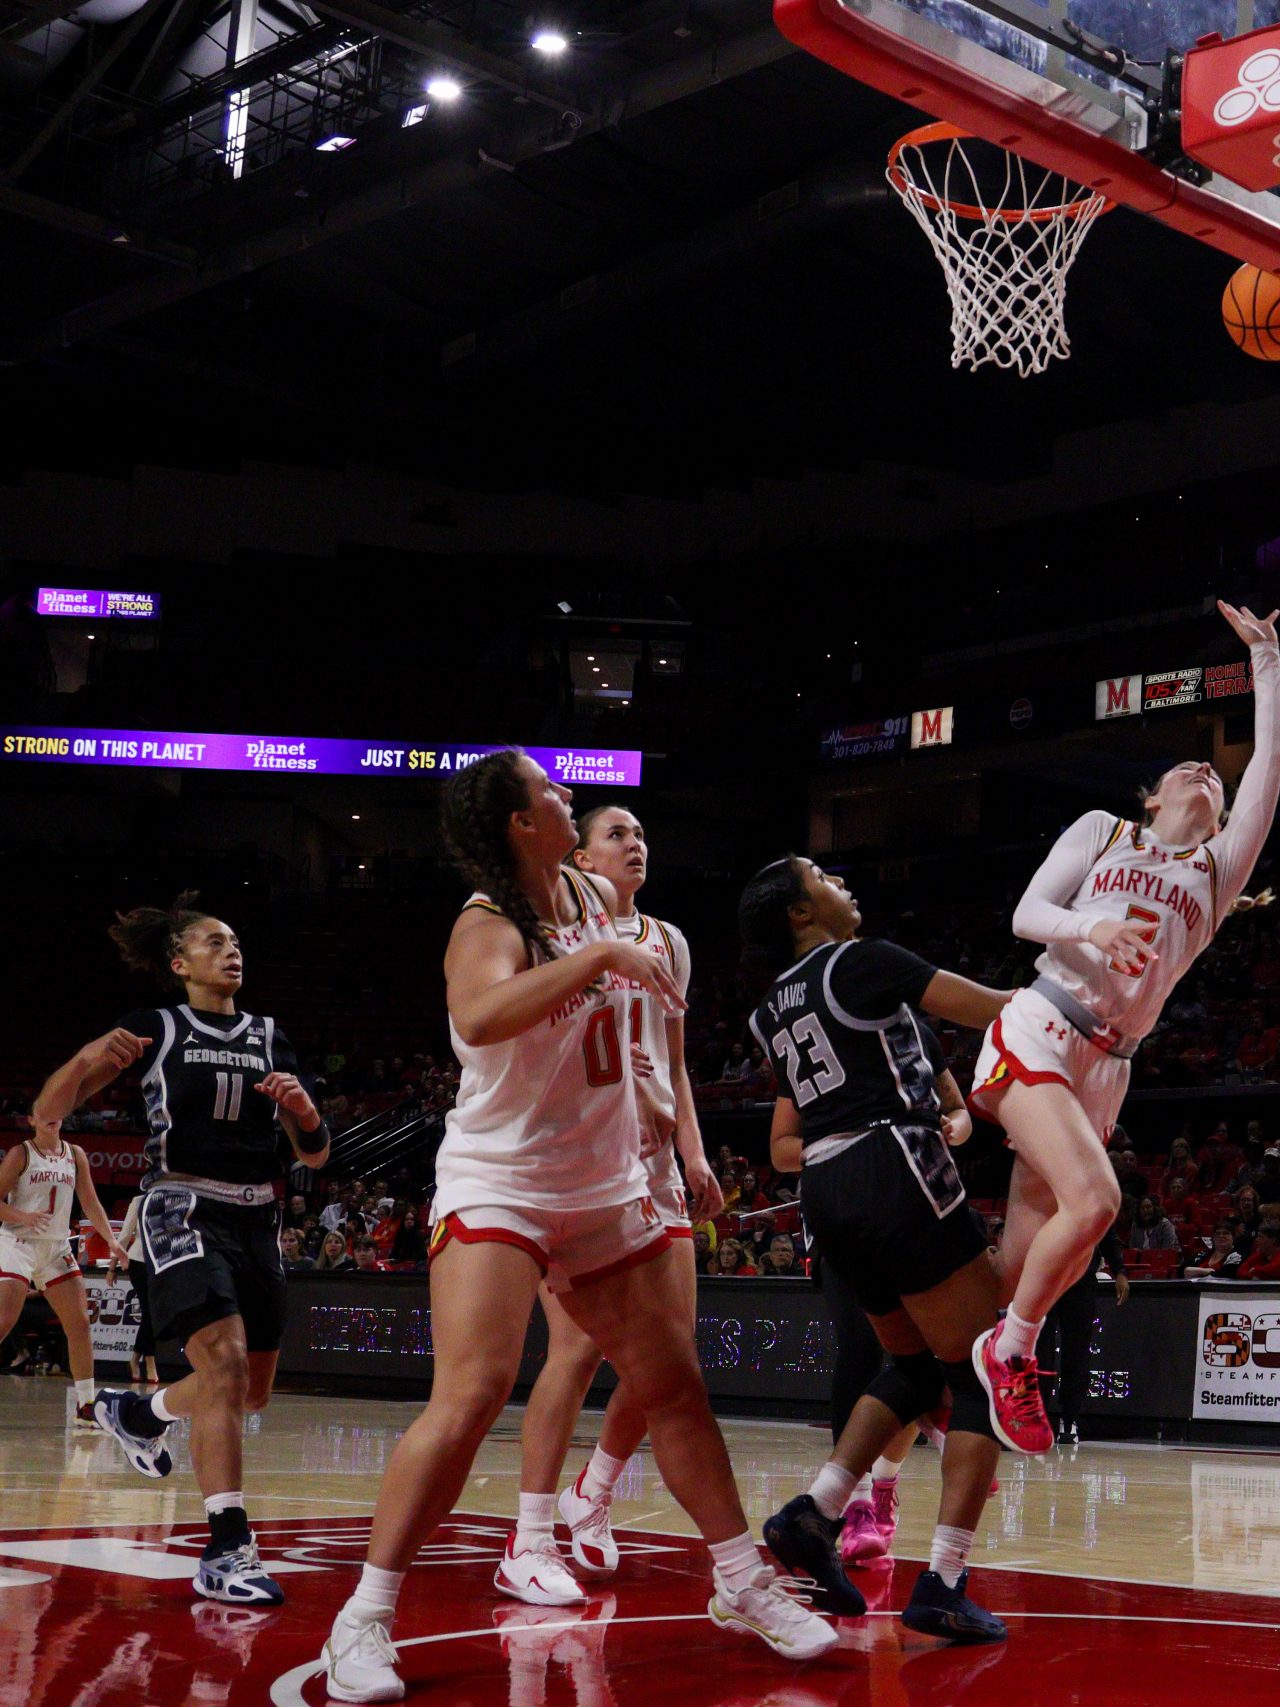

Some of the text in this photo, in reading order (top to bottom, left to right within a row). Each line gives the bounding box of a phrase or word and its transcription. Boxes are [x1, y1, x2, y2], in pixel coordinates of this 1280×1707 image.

[43, 591, 88, 604] planet
[106, 601, 153, 611] STRONG
[136, 594, 153, 603] ALL
[48, 601, 97, 614] fitness
[1149, 669, 1200, 683] SPORTS RADIO
[1205, 662, 1246, 682] HOME
[1106, 678, 1131, 712] M
[1151, 693, 1197, 708] BALTIMORE
[919, 709, 943, 743] M
[4, 735, 206, 761] STRONG ON THIS PLANET
[246, 740, 306, 758] planet
[253, 754, 317, 770] fitness
[361, 749, 404, 768] JUST
[408, 750, 436, 769] $15
[440, 752, 451, 769] A
[555, 752, 613, 770] planet
[562, 766, 625, 782] fitness
[1090, 866, 1202, 932] MARYLAND
[776, 981, 808, 1014] DAVIS
[582, 1004, 623, 1088] 0
[184, 1049, 266, 1072] GEORGETOWN
[771, 1011, 846, 1109] 23
[213, 1071, 244, 1122] 11
[86, 1151, 150, 1168] OYOT
[243, 1187, 254, 1202] G
